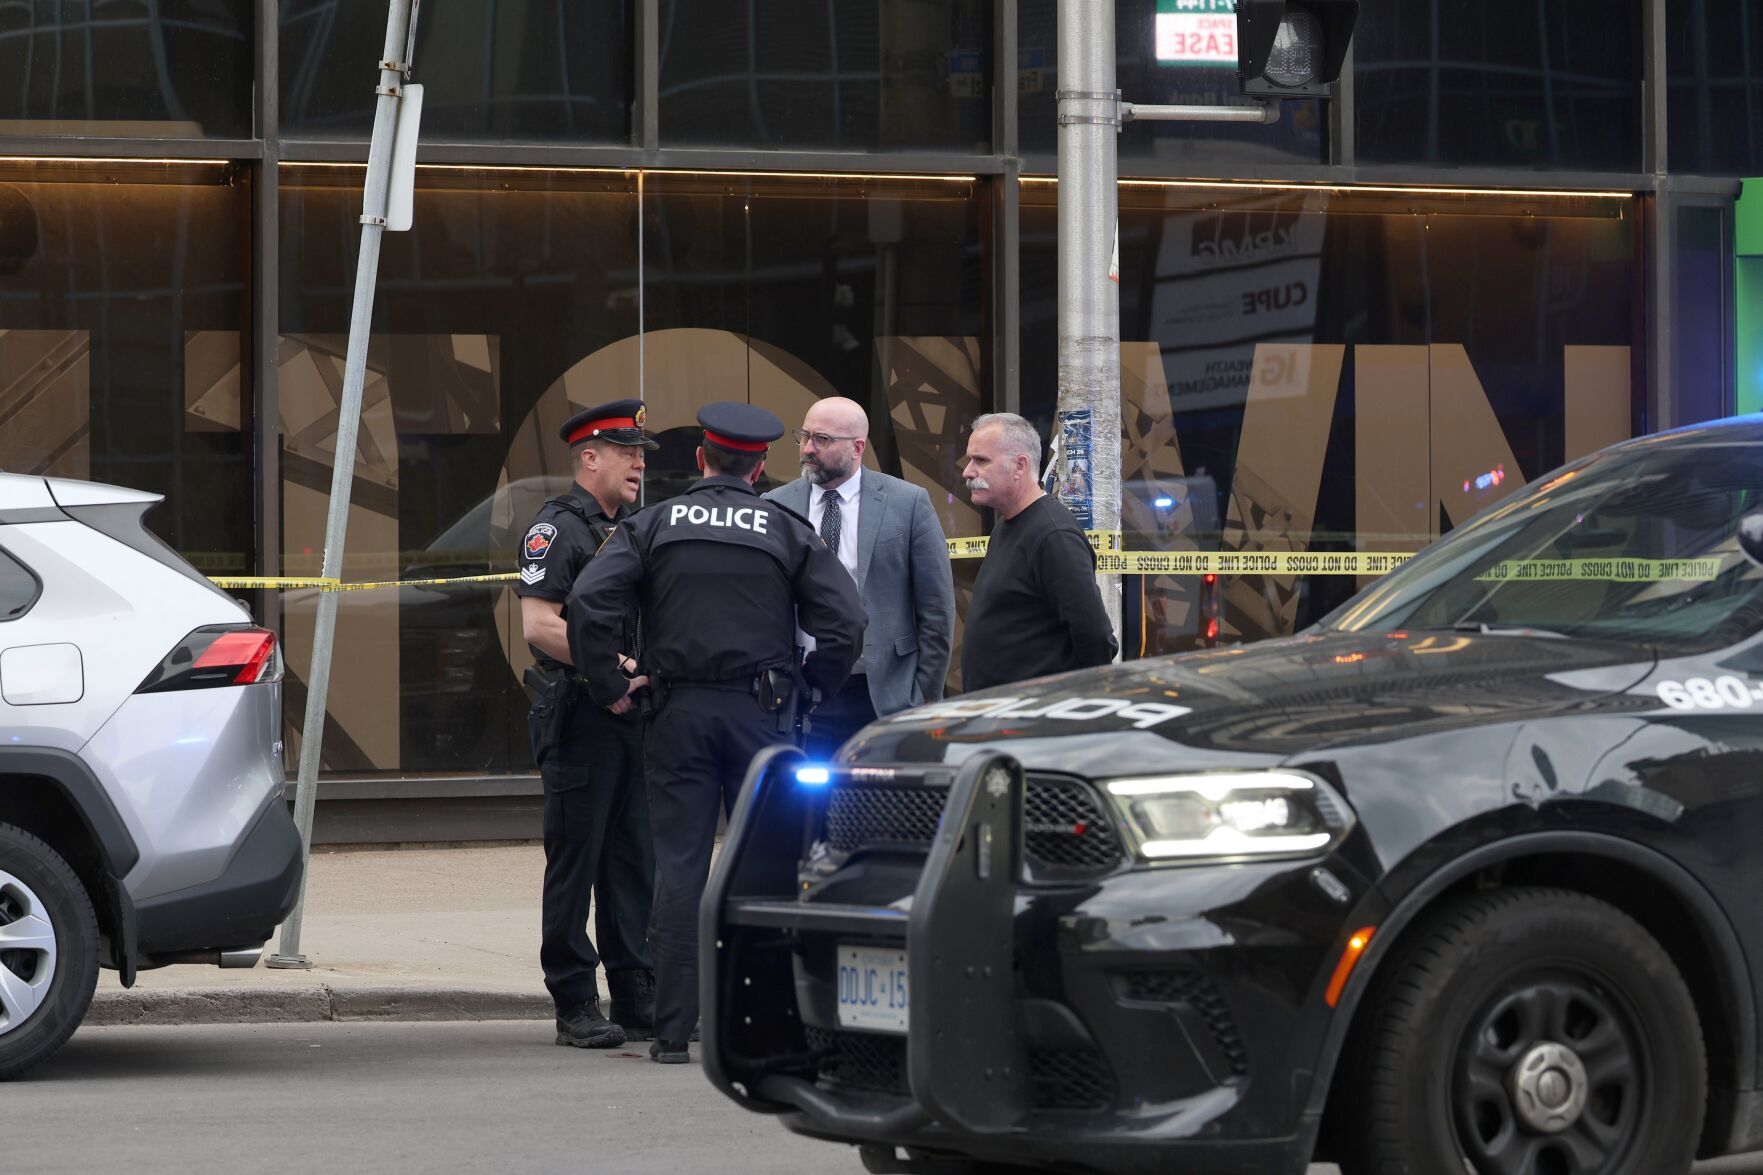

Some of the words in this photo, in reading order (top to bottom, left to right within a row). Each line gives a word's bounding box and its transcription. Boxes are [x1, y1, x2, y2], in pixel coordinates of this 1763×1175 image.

[670, 504, 769, 535] POLICE
[1097, 554, 1128, 570] POLIC
[1137, 555, 1170, 571] CROSS
[1172, 555, 1192, 571] NOT
[1195, 555, 1209, 571] DO
[1218, 555, 1239, 571] LINE
[1243, 555, 1278, 571] POLICE
[1287, 556, 1319, 571] CROSS
[1322, 556, 1341, 571] NOT
[1344, 556, 1357, 571] DO
[1366, 556, 1388, 571] LINE
[1516, 562, 1538, 577] LINE
[1540, 562, 1573, 577] POLICE
[1581, 562, 1612, 577] CROSS
[1615, 561, 1635, 579] NOT
[1658, 562, 1679, 578] LINE
[1681, 561, 1714, 577] POLICE
[1638, 563, 1650, 578] DO
[1656, 674, 1763, 711] 680-
